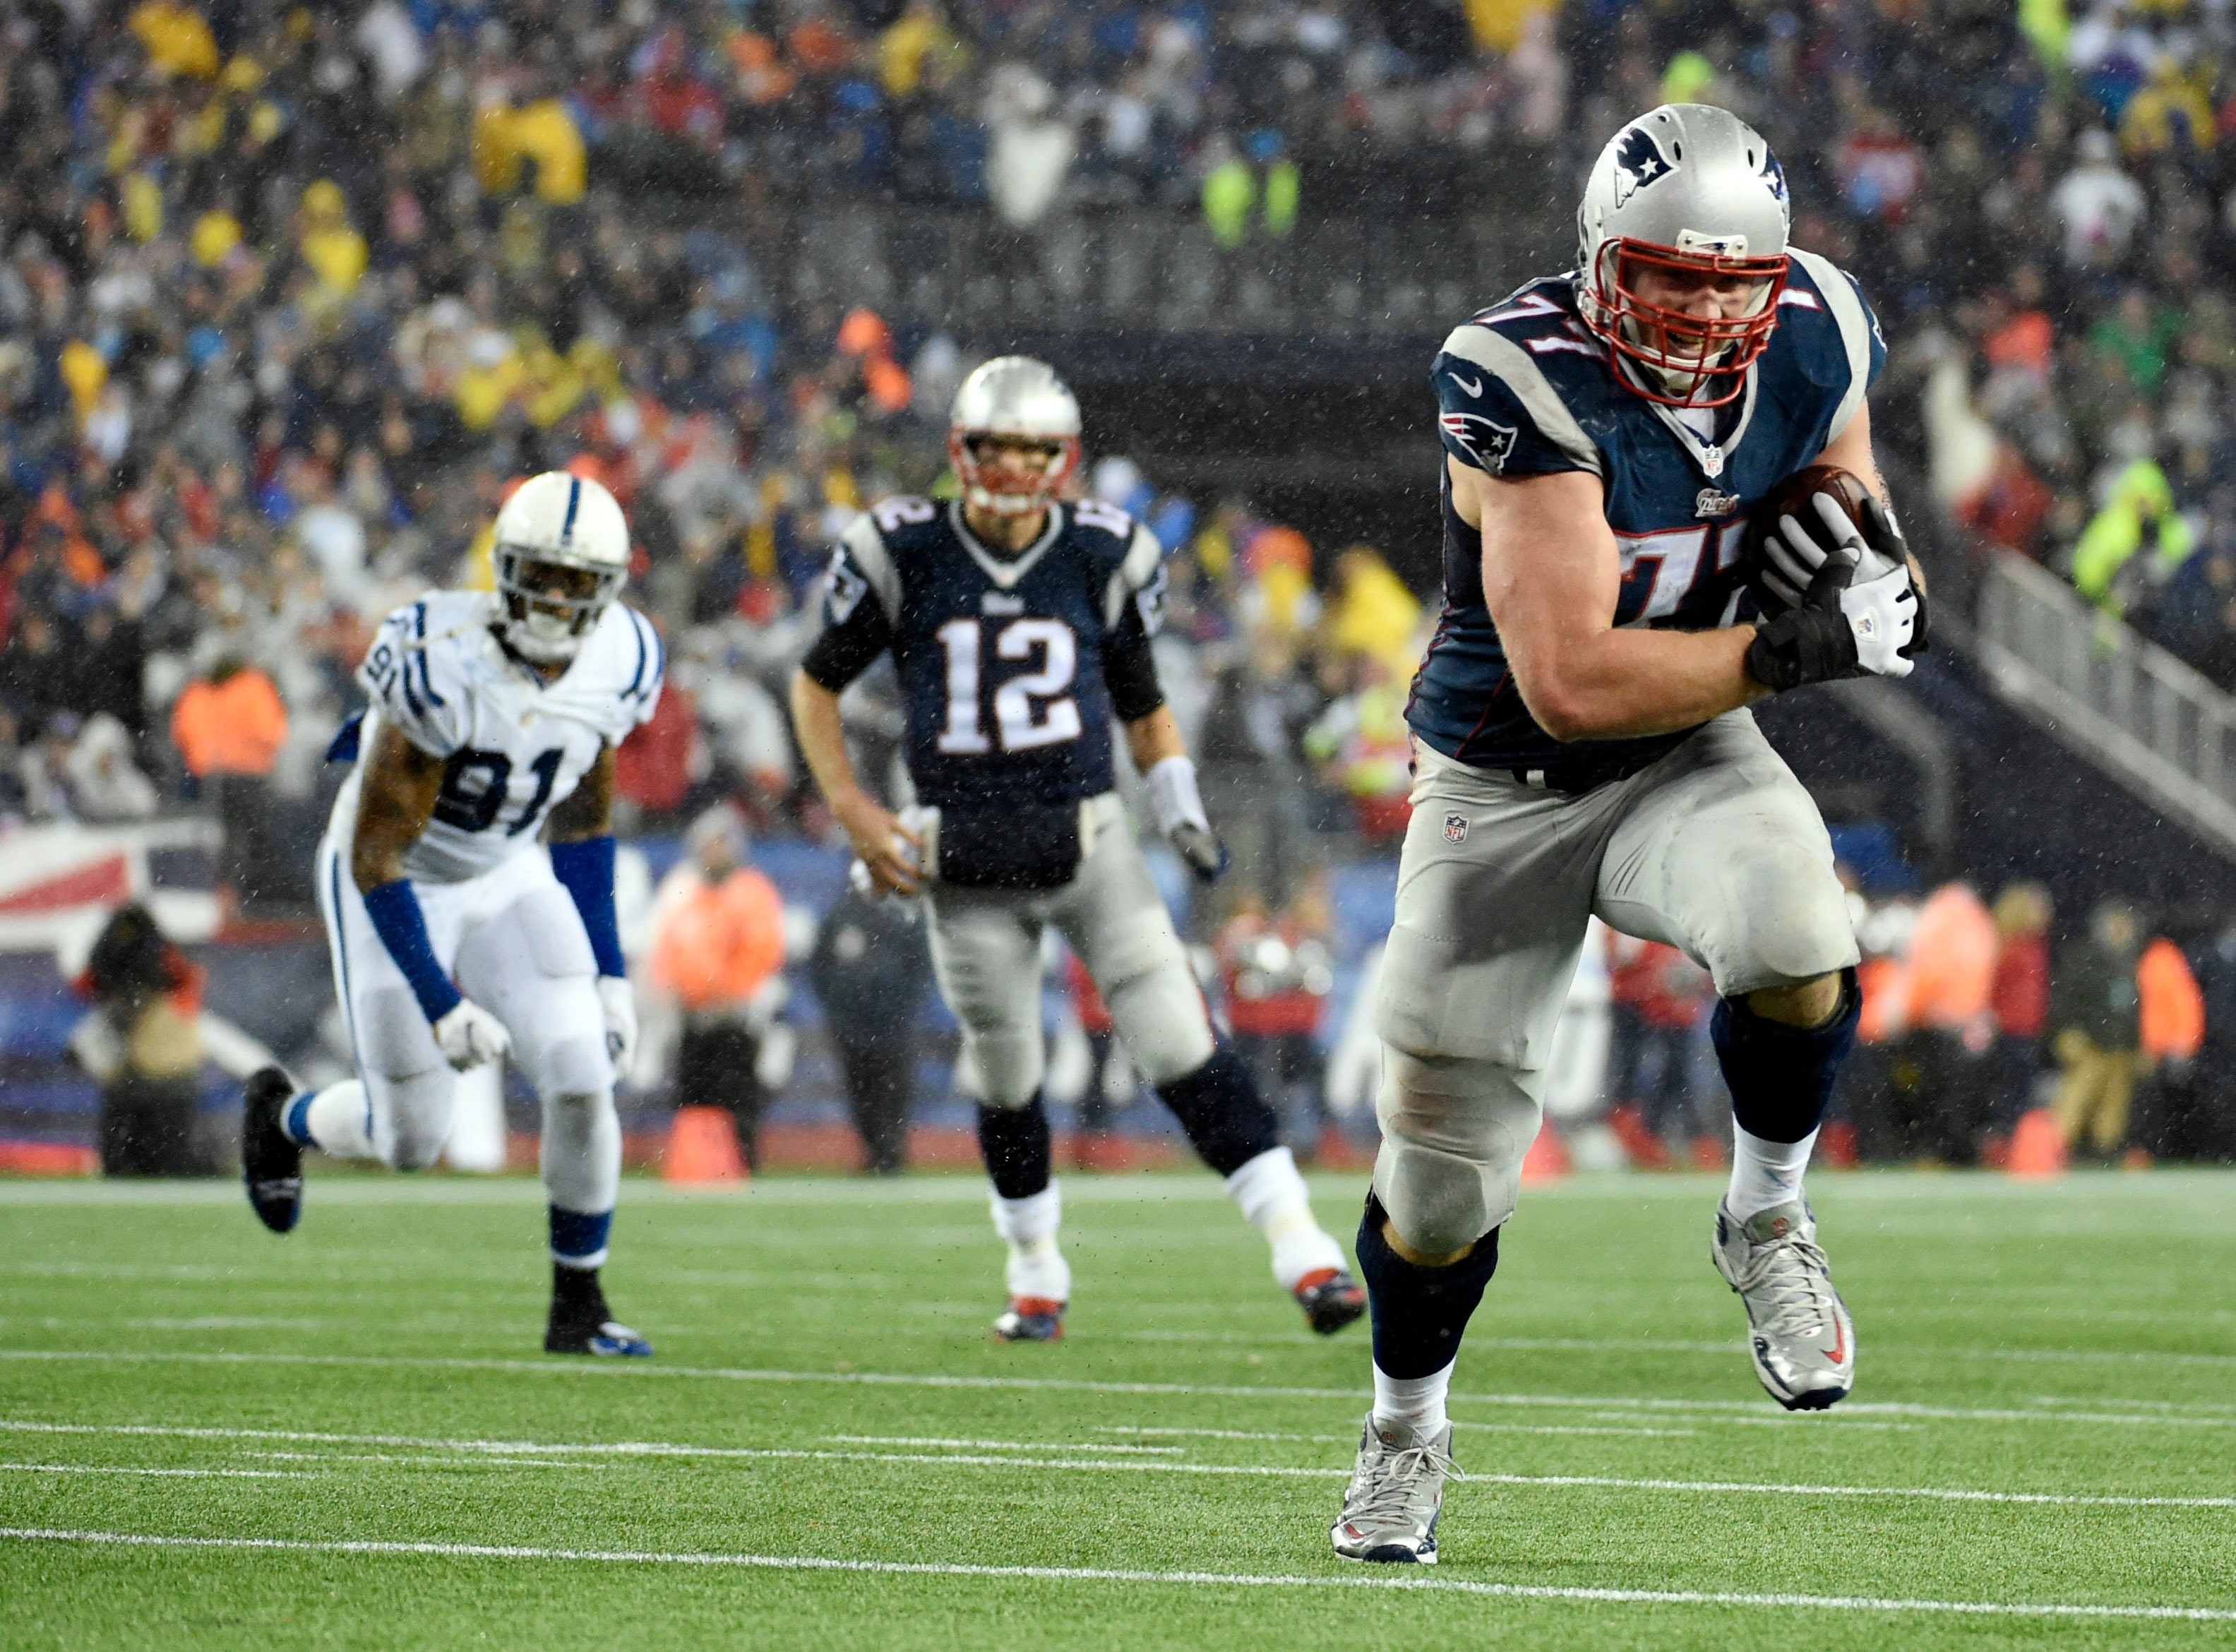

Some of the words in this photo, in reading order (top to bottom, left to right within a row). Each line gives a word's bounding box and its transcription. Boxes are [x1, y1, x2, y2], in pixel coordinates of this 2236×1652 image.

[935, 618, 1082, 753] 12
[434, 746, 564, 838] 91
[1446, 826, 1463, 839] NFL
